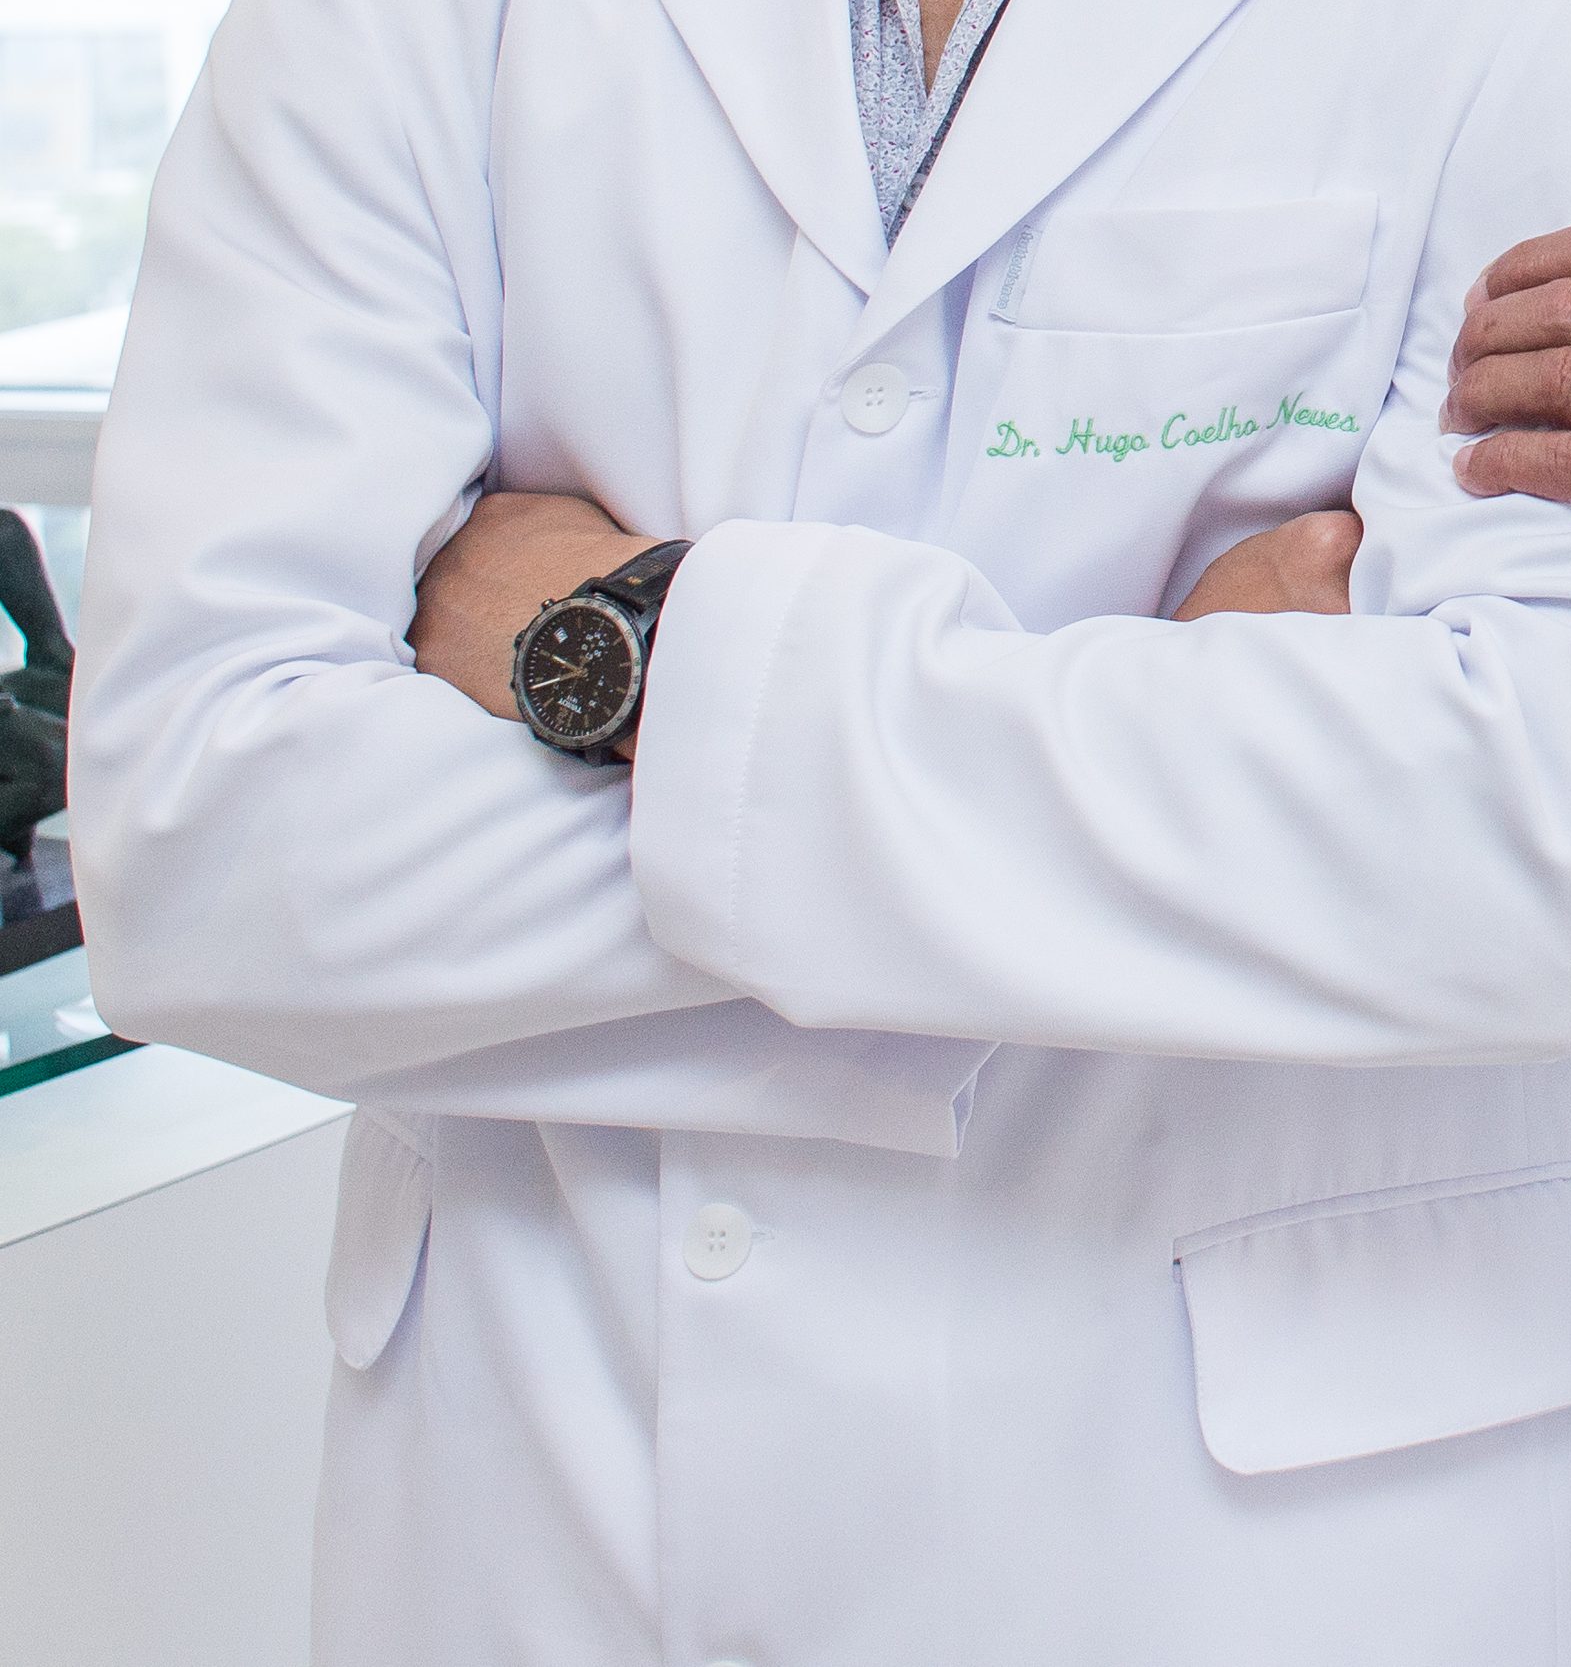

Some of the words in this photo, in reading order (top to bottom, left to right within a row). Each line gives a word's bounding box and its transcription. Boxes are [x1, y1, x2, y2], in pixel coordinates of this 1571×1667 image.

[985, 418, 1040, 459] Dr.
[1055, 415, 1150, 463] Hugo
[1158, 406, 1260, 452] Coelho
[1268, 391, 1361, 434] Neves
